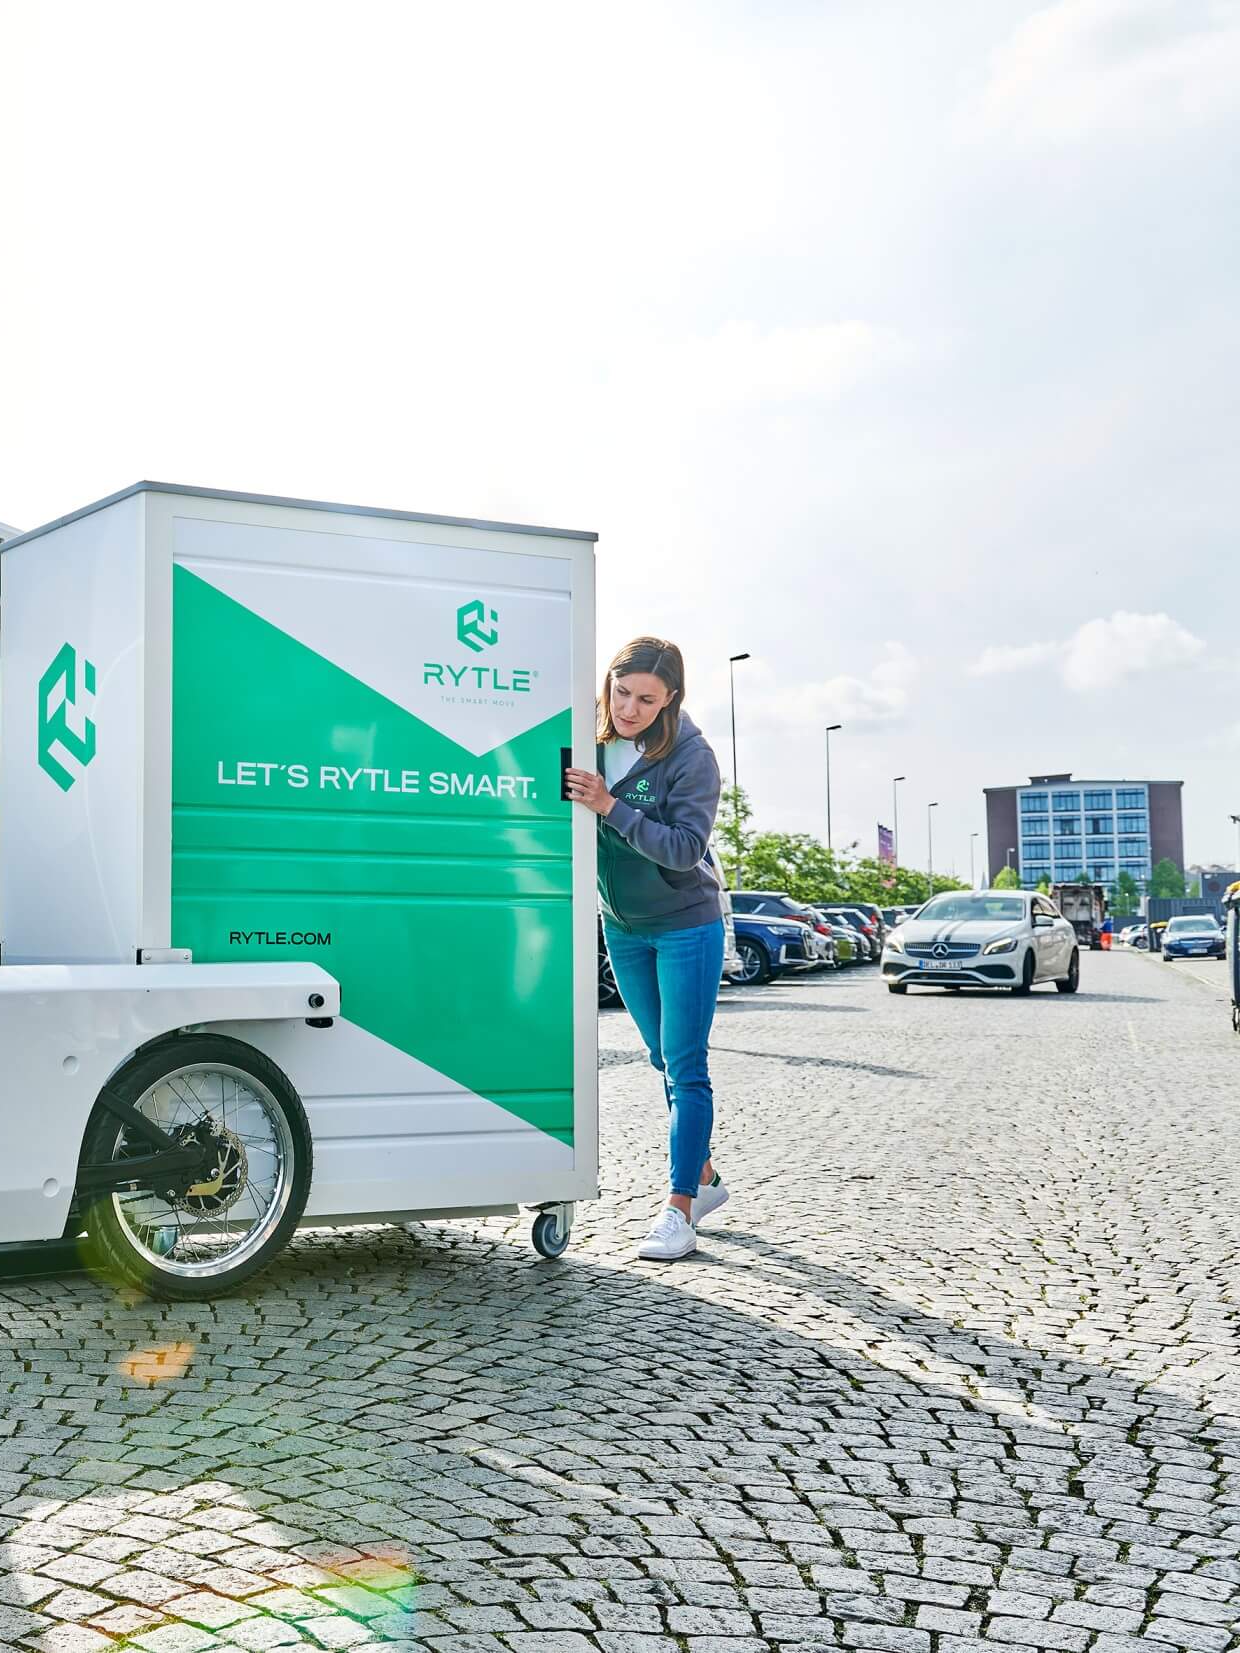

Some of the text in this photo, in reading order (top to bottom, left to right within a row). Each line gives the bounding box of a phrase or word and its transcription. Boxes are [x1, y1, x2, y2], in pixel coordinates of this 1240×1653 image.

[441, 695, 456, 704] THE
[461, 696, 488, 706] SMART
[319, 766, 420, 793] RYTLE
[428, 772, 538, 799] SMART.
[625, 792, 656, 802] RYTLE
[229, 931, 332, 945] RYTLE.COM
